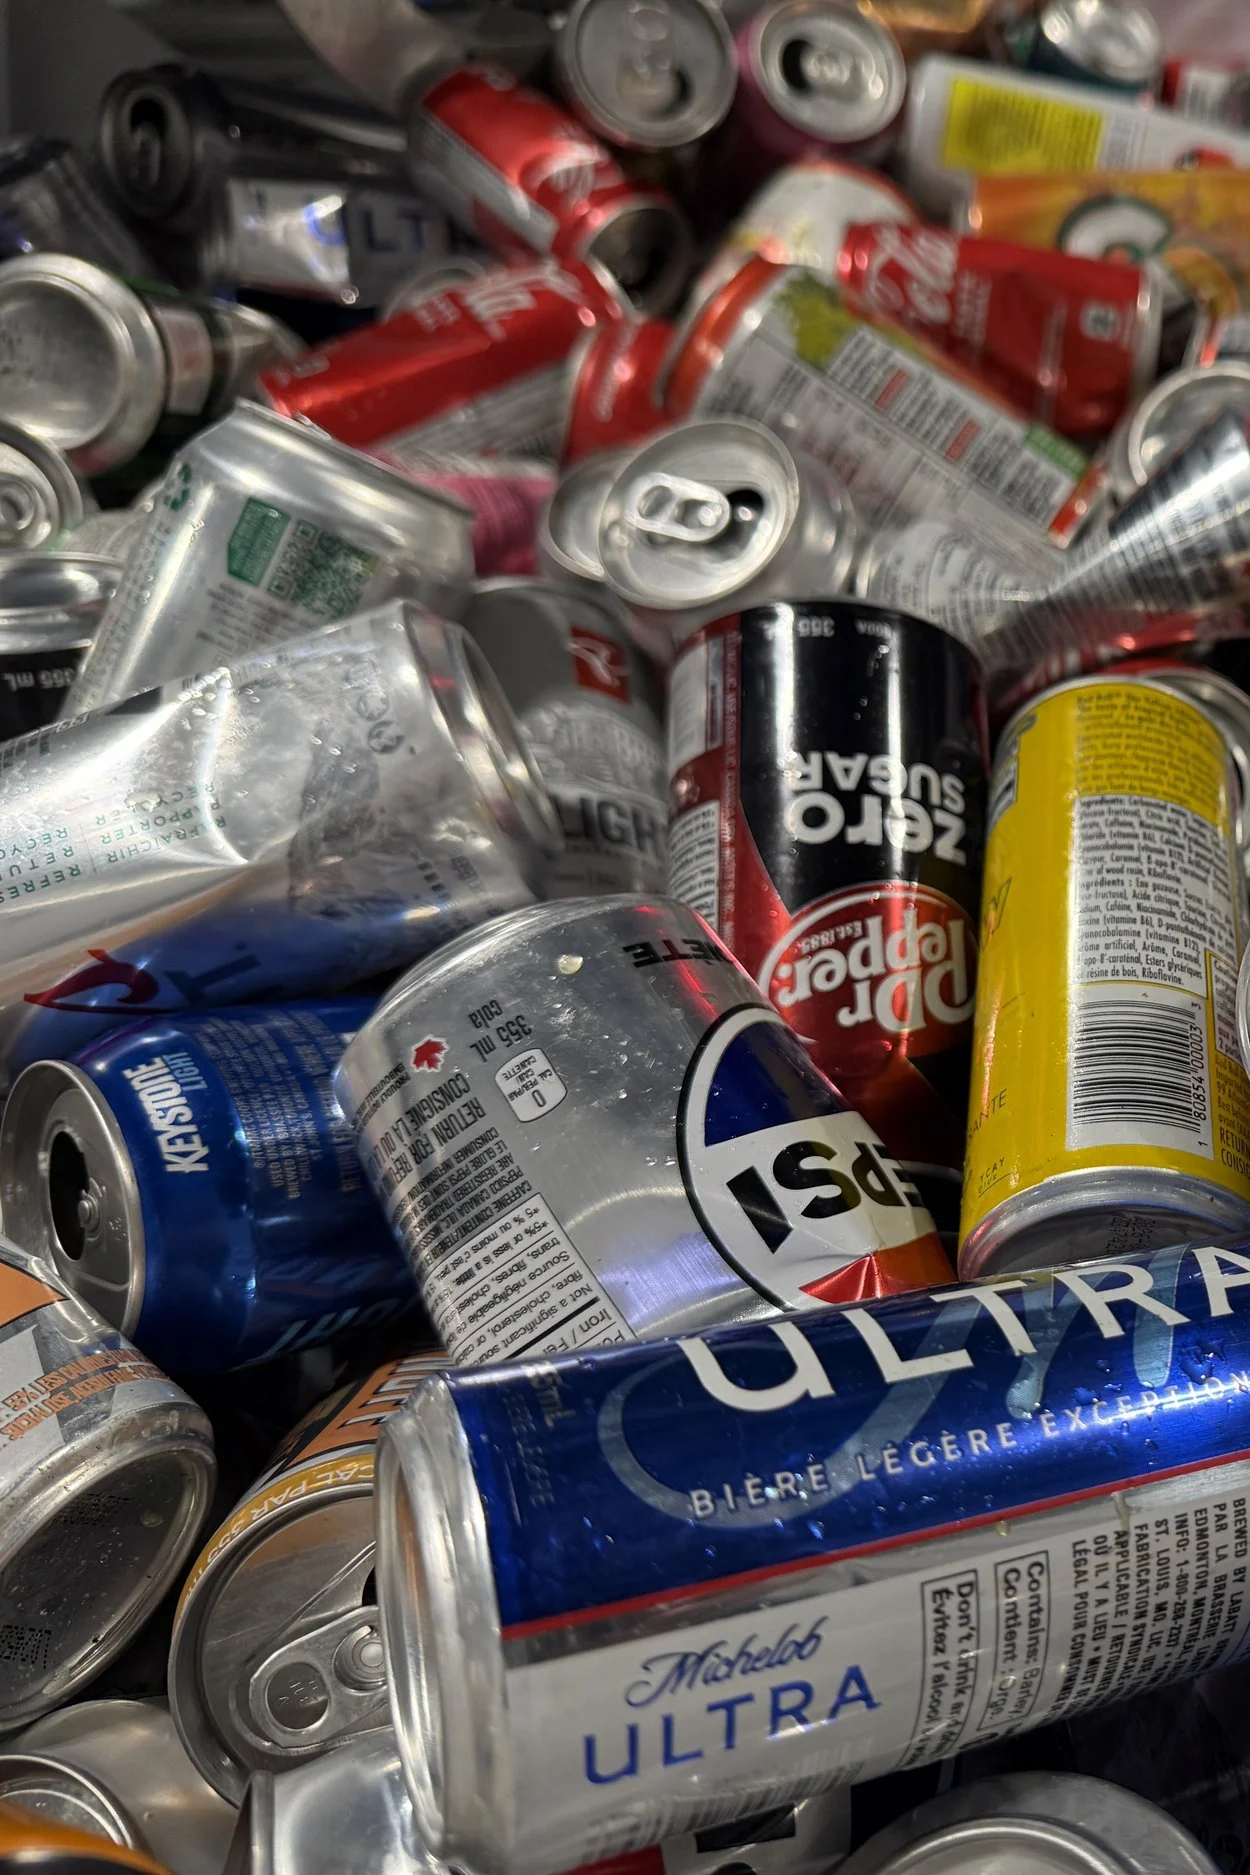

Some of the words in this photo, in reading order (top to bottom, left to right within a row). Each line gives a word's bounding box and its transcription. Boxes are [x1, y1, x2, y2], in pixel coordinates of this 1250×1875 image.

[0, 671, 35, 690] mL
[776, 749, 966, 814] SUGAR
[100, 800, 220, 845] RPPORTER
[106, 816, 226, 864] RFRAÎCHIR
[781, 789, 966, 865] zero
[0, 845, 74, 881] RETU
[1080, 878, 1125, 890] ngrédients
[1104, 938, 1138, 951] artificiel,
[1143, 942, 1168, 956] Arôme,
[1145, 953, 1165, 965] Esters
[1087, 966, 1109, 978] résine
[1111, 966, 1120, 977] de
[1122, 967, 1139, 979] bois,
[1142, 967, 1184, 985] Riboflavine.
[466, 997, 507, 1033] cola
[836, 966, 925, 1033] Dr
[468, 1033, 500, 1065] mL
[493, 1012, 534, 1049] 355
[163, 1050, 209, 1090] LIGHT
[499, 1052, 538, 1082] CANETTE
[120, 1056, 209, 1173] KEYSTONE
[529, 1087, 547, 1108] 0
[388, 1116, 416, 1148] LÀ
[429, 1095, 487, 1147] RETURN
[405, 1131, 437, 1166] FOR
[451, 1124, 500, 1163] CONSUMER
[467, 1145, 498, 1171] GLOBE
[494, 1151, 517, 1171] ARE
[469, 1229, 501, 1255] moins
[490, 1240, 513, 1259] less
[527, 1234, 561, 1262] trans,
[489, 1258, 529, 1289] fibres,
[526, 1248, 571, 1284] Source
[550, 1268, 584, 1295] fibre,
[465, 1275, 530, 1326] négligeable
[567, 1281, 593, 1303] Not
[485, 1289, 553, 1340] cholesterol,
[500, 1302, 560, 1350] significant
[576, 1306, 613, 1336] Iron
[688, 1462, 832, 1519] BIÈRE
[857, 1418, 1020, 1482] LÉGÈRE
[245, 1476, 311, 1523] PAR
[1211, 1502, 1227, 1533] PAR
[1173, 1513, 1189, 1554] INFO:
[1231, 1497, 1247, 1559] BREWED
[1071, 1539, 1090, 1588] LÉGAL
[1192, 1507, 1208, 1597] EDMONTON,
[1113, 1528, 1131, 1618] APPLICABLE
[1133, 1523, 1149, 1622] FABRICATION
[1233, 1566, 1248, 1585] BY
[931, 1585, 952, 1657] Évitez
[953, 1580, 978, 1643] Don't
[1000, 1565, 1020, 1664] Contient
[1025, 1559, 1043, 1665] Contains:
[1073, 1591, 1089, 1630] POUR
[1093, 1611, 1109, 1642] LIEU
[1203, 1574, 1226, 1640] BRASSERIE
[1222, 1591, 1244, 1635] LABATT
[625, 1615, 831, 1709] Michelob
[952, 1647, 975, 1698] drink
[1055, 1632, 1085, 1703] CONSOMMER
[583, 1662, 882, 1785] ULTRA
